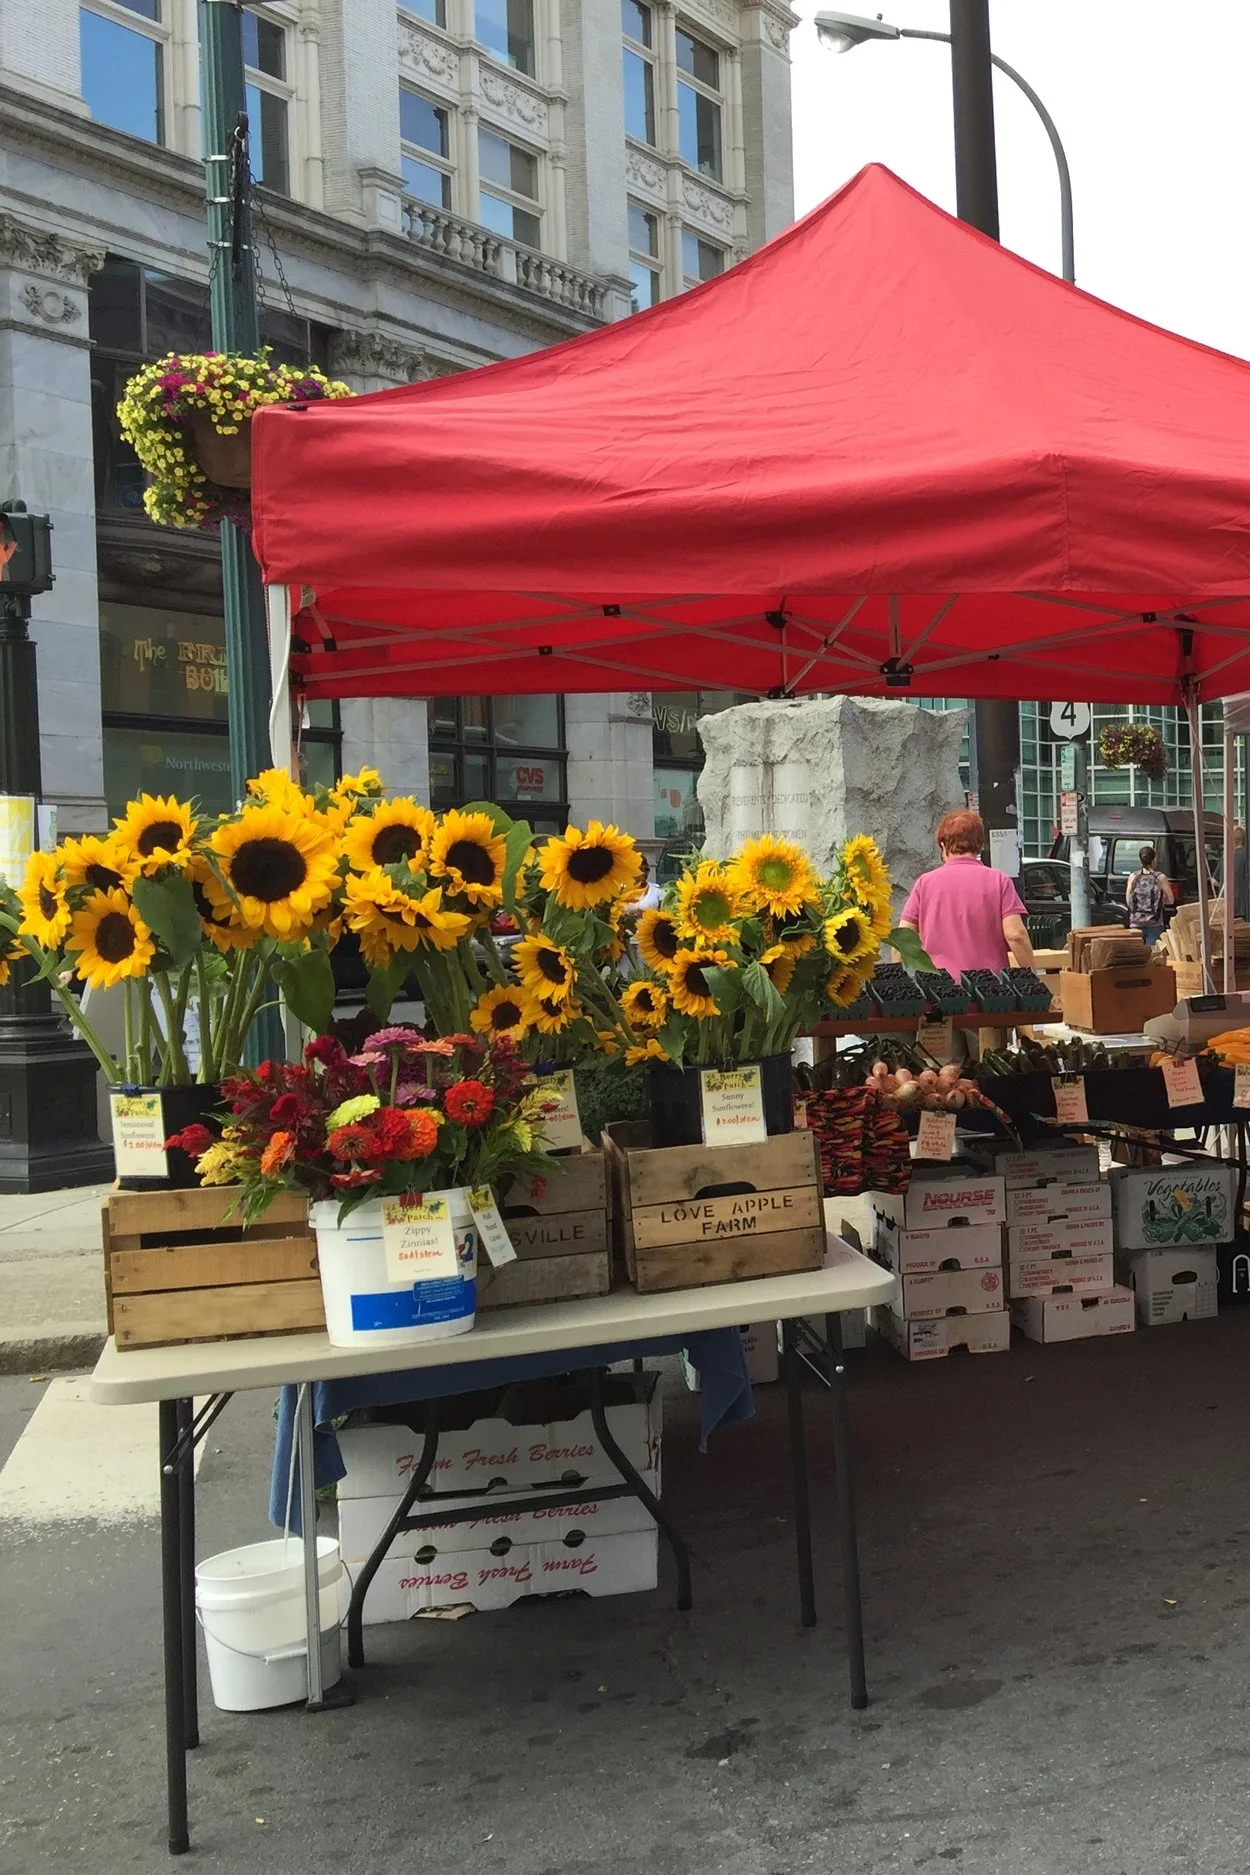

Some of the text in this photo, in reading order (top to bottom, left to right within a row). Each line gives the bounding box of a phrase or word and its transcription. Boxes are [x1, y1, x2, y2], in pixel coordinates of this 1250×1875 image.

[133, 638, 167, 672] The
[1061, 702, 1077, 727] 4
[165, 756, 232, 772] Northweste
[515, 767, 544, 785] CVS
[923, 1188, 995, 1206] NOURSE
[1144, 1177, 1222, 1201] Vegetables
[661, 1195, 793, 1224] LOVE APPLE
[405, 1226, 432, 1236] Zippy
[702, 1216, 757, 1235] FARM
[400, 1237, 438, 1249] Zinnias!
[396, 1443, 594, 1477] Fam Fresh Berries
[398, 1553, 598, 1591] Farm Fresh Berries
